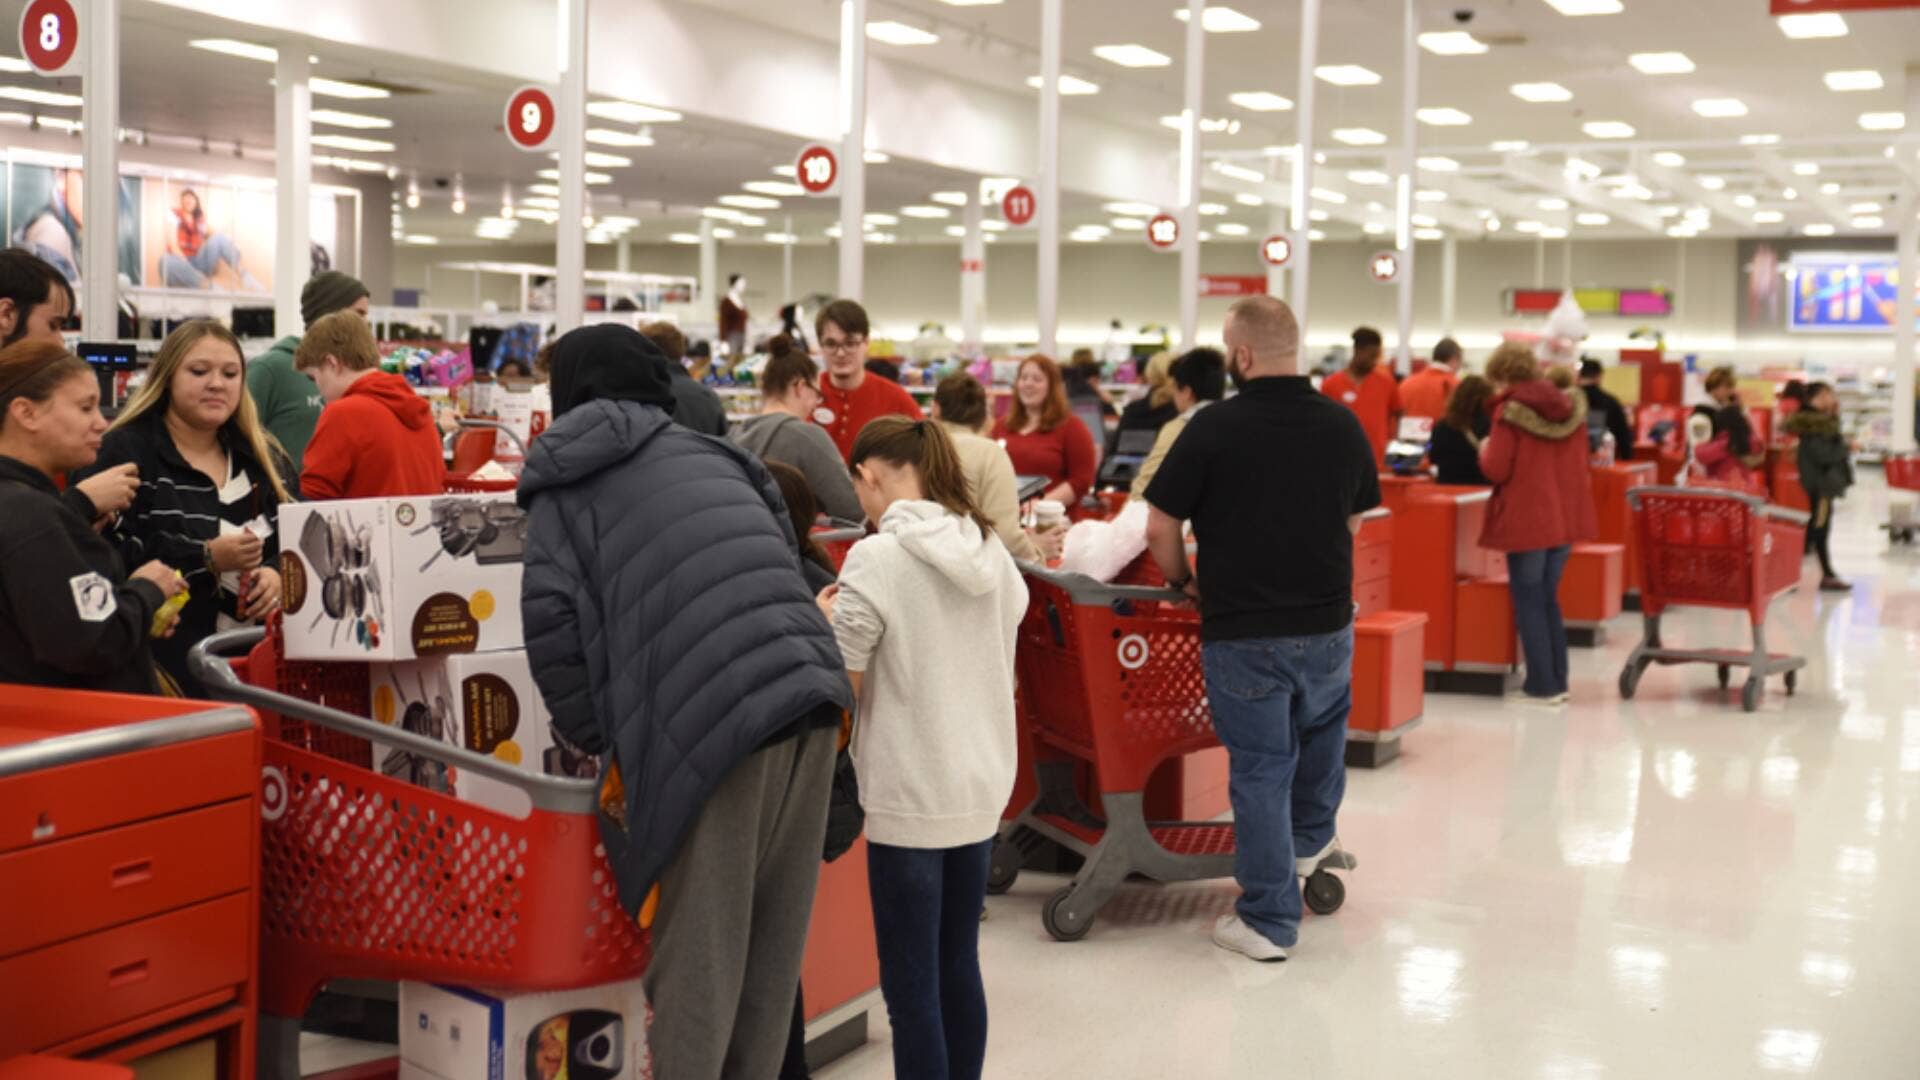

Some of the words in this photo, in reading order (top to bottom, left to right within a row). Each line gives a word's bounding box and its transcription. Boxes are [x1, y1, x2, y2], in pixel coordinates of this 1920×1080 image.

[40, 12, 60, 51] 8
[521, 101, 541, 133] 9
[803, 155, 831, 183] 10
[1010, 197, 1028, 216] 11
